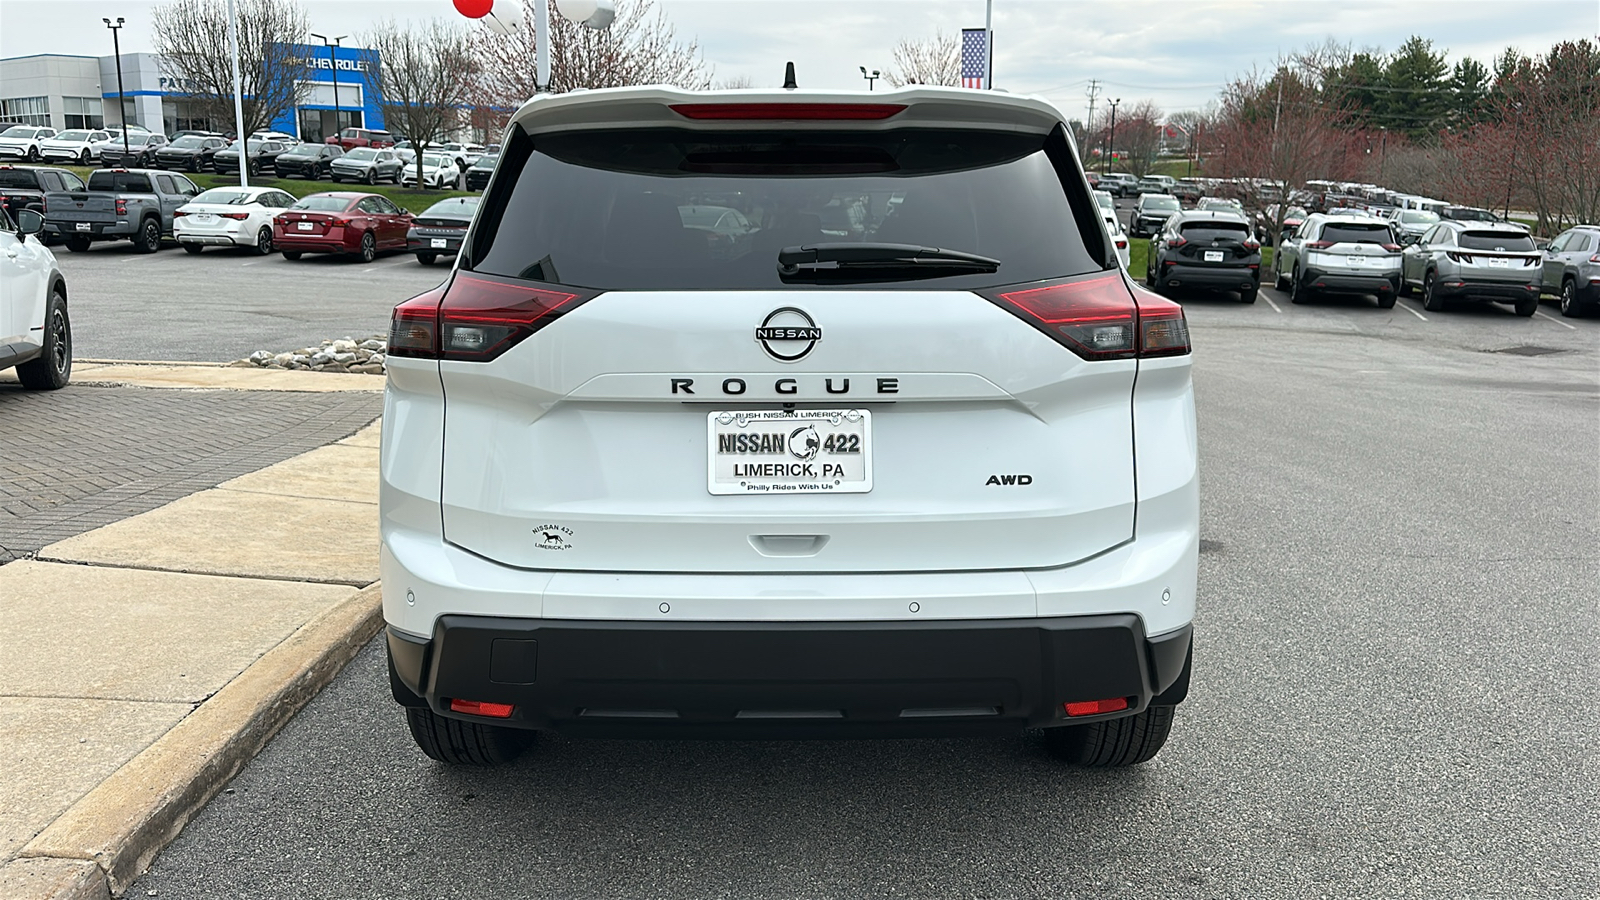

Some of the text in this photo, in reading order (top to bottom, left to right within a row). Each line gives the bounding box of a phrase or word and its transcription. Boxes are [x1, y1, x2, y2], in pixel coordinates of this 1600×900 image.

[757, 329, 820, 338] NISSAN
[671, 378, 899, 395] ROGUE
[718, 433, 860, 454] NISSAN 422
[734, 464, 845, 478] LIMERICK, PA
[985, 475, 1032, 485] AWD
[532, 524, 574, 536] NISSAN 422
